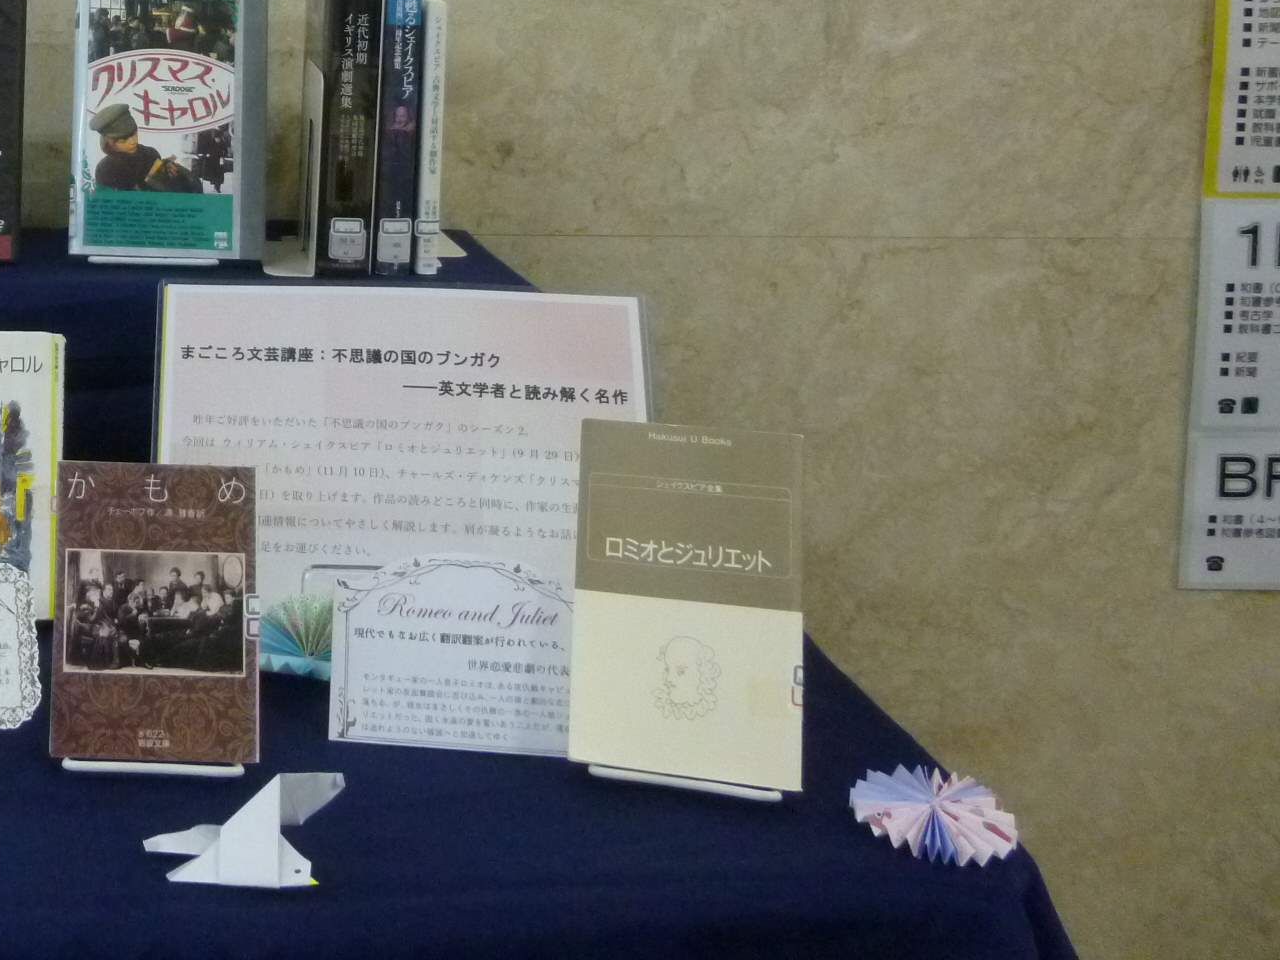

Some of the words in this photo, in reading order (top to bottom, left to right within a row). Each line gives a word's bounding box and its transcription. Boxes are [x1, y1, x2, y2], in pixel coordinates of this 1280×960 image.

[356, 13, 369, 66] 近代初期
[339, 13, 356, 110] イギリス演劇選集
[132, 84, 231, 127] キャロル
[180, 345, 502, 369] まごころ文芸講座：不思議の国のブンガク
[701, 435, 732, 447] Books
[68, 471, 246, 504] かもめ
[605, 537, 772, 573] ロミオとジュリエット
[377, 593, 453, 618] Romeo
[458, 604, 496, 623] and
[497, 601, 560, 629] Juliet
